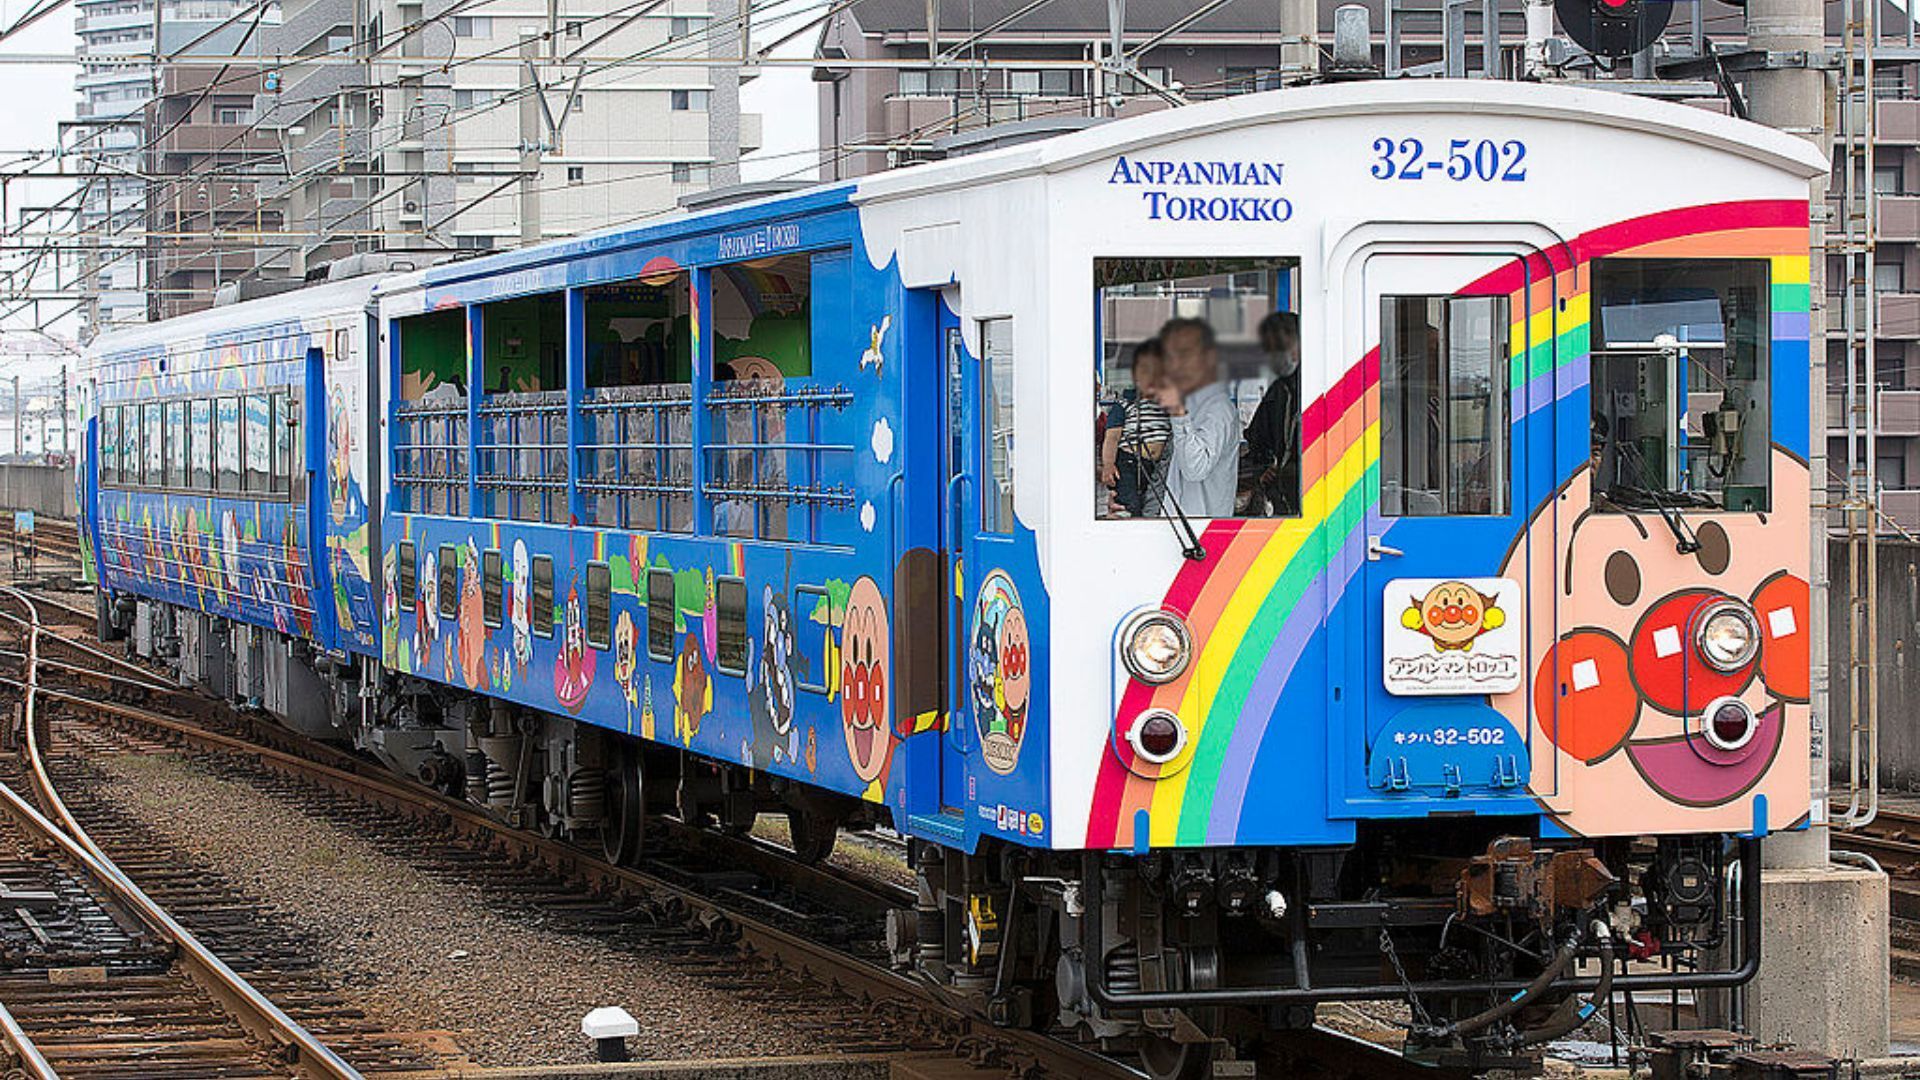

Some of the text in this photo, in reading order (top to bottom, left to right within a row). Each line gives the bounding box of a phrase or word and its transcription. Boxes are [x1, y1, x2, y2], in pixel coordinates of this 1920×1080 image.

[1108, 156, 1285, 186] ANPANMAN
[1370, 137, 1527, 182] 32-502
[1142, 191, 1293, 222] TOROKKO
[1394, 661, 1509, 675] アンパンマントロッコ
